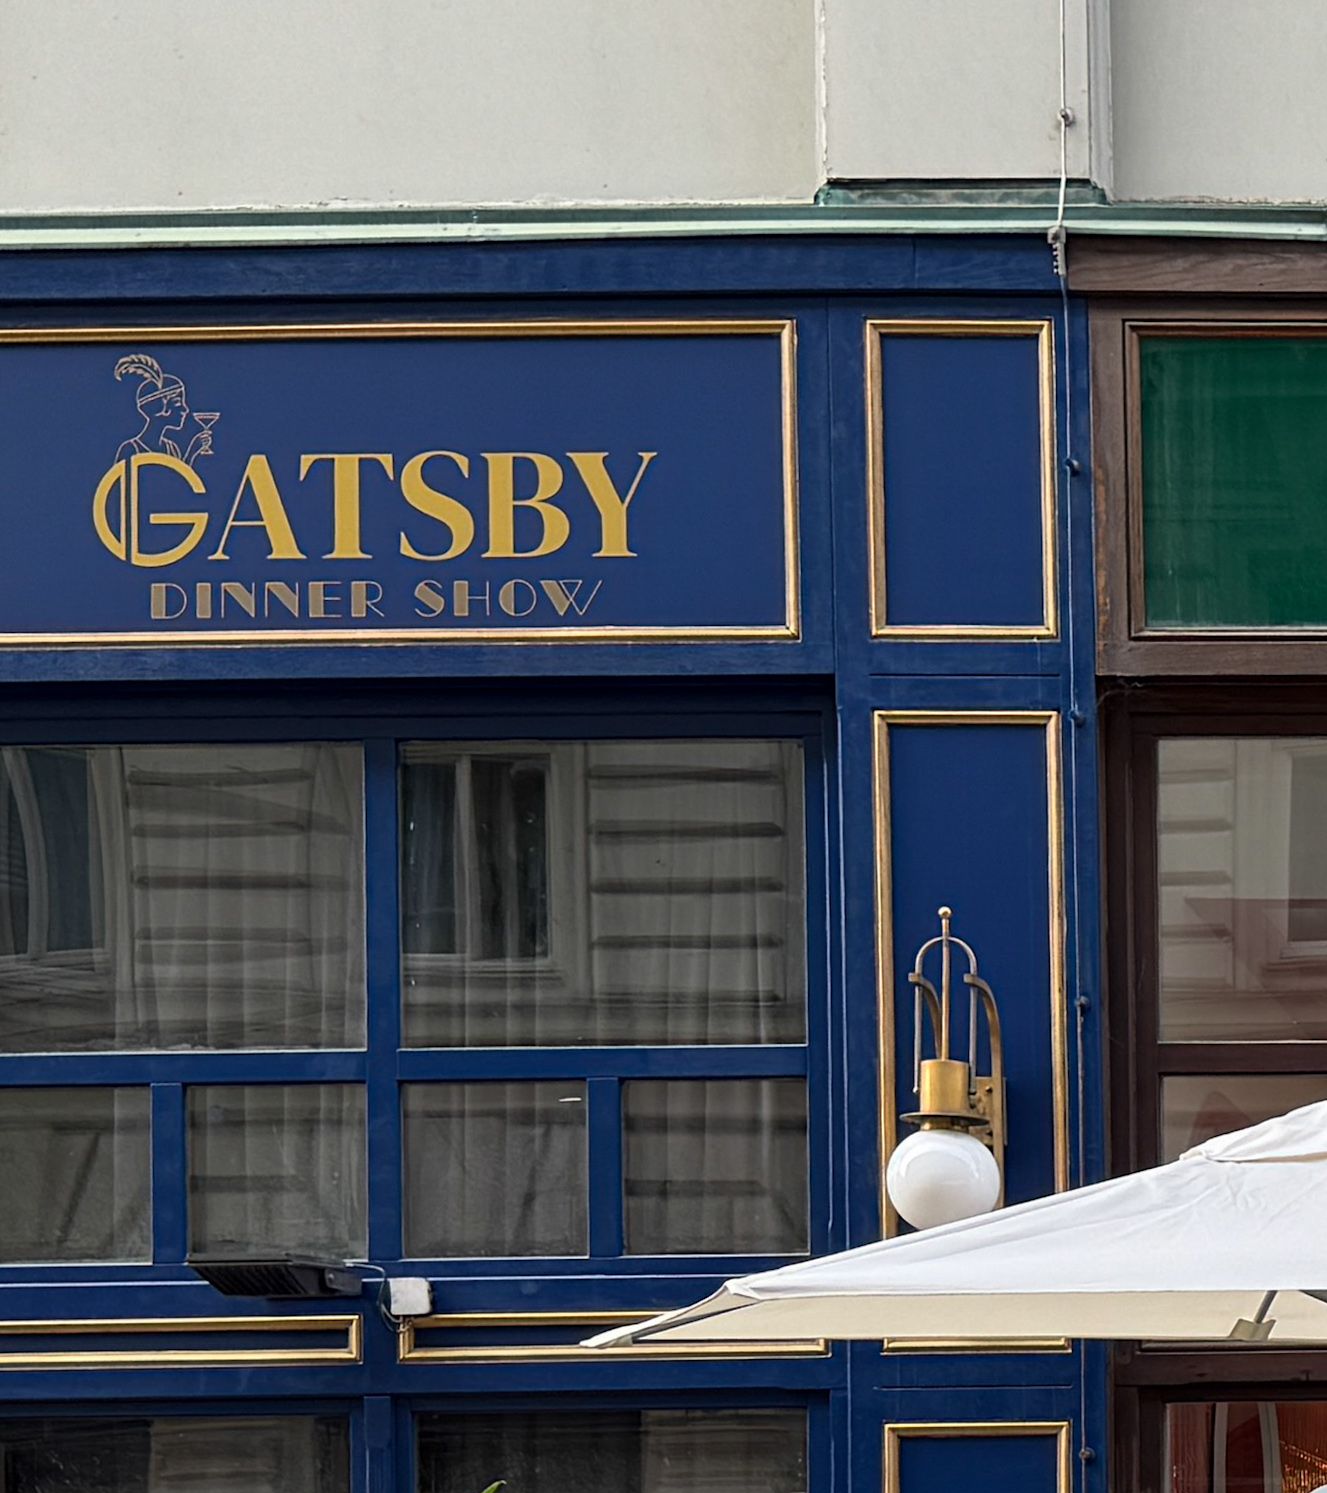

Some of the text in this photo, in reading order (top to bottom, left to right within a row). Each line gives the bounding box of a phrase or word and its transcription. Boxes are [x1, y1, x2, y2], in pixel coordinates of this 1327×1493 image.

[92, 450, 658, 568] GATSBY
[150, 578, 604, 620] DINNER SHOW
